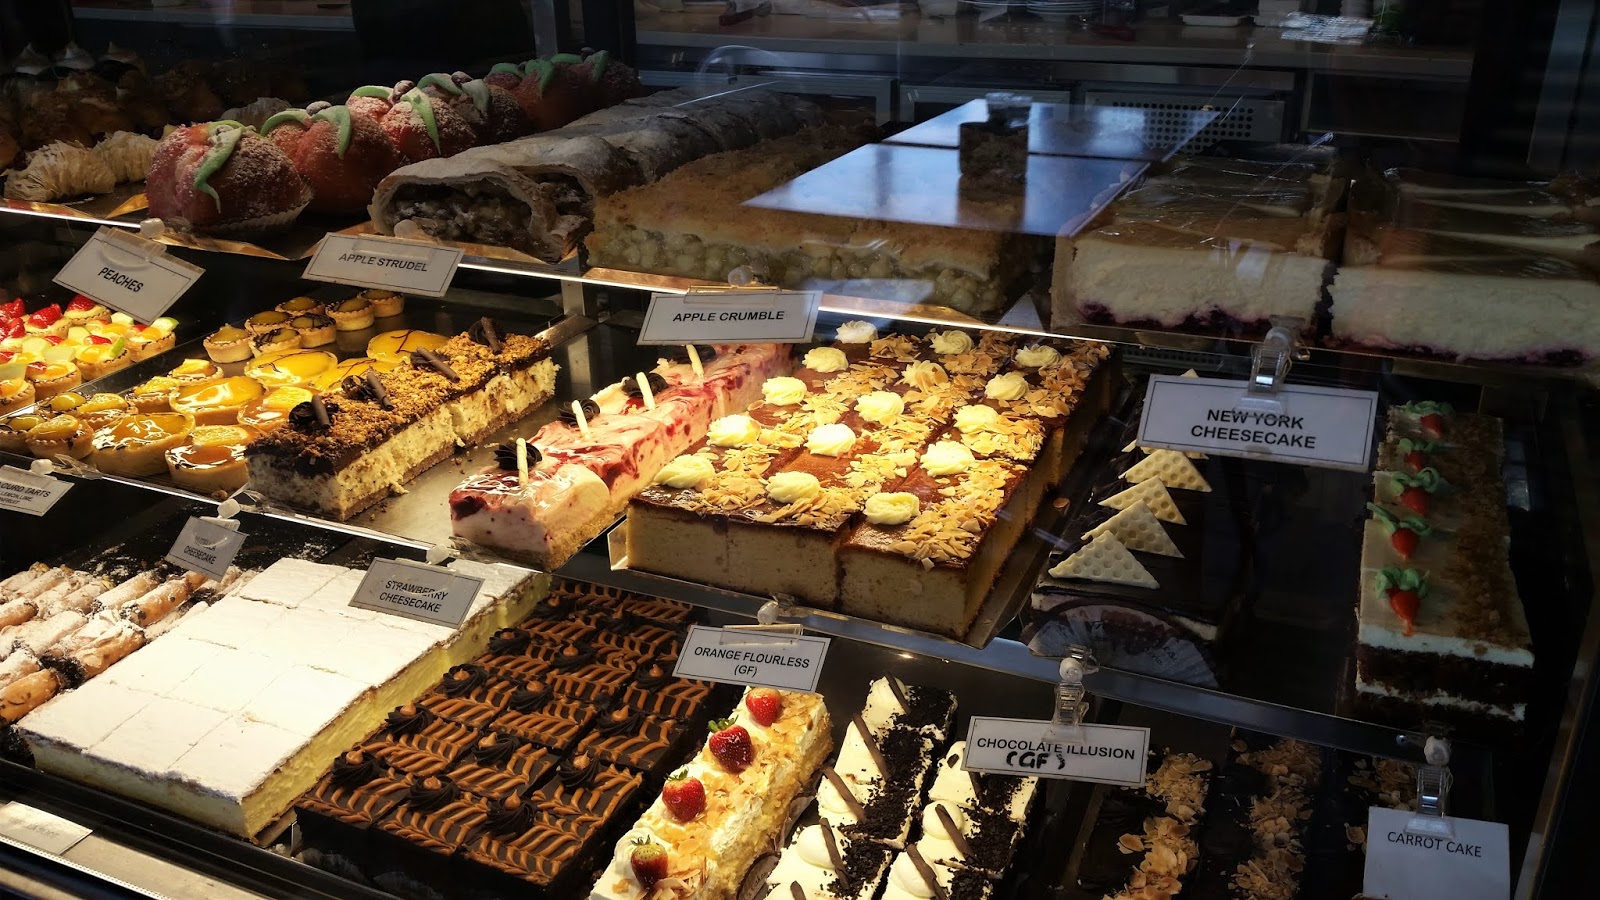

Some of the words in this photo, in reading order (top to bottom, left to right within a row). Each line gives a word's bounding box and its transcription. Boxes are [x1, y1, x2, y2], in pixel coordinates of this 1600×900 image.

[338, 253, 376, 266] APPLE
[377, 258, 428, 272] STRUDEL
[98, 267, 144, 293] PEACHES
[672, 312, 717, 322] APPLE
[719, 311, 785, 322] CRUMBLE
[1207, 409, 1249, 424] NEW
[1252, 412, 1304, 430] YORK
[1191, 425, 1317, 449] CHEESECAKE
[0, 482, 25, 493] CURD
[24, 488, 51, 498] TARTS
[183, 545, 217, 565] CHEESECAKE
[385, 580, 449, 601] STRAWBERRY
[379, 592, 442, 613] CHEESECAKE
[694, 646, 742, 661] ORANGE
[743, 652, 810, 669] FLOURLESS
[734, 664, 758, 678] (GF)
[977, 738, 1063, 753] CHOCOLATE
[1066, 745, 1135, 760] ILLUSION
[1387, 831, 1443, 851] CARROT
[1446, 841, 1482, 858] CAKE
